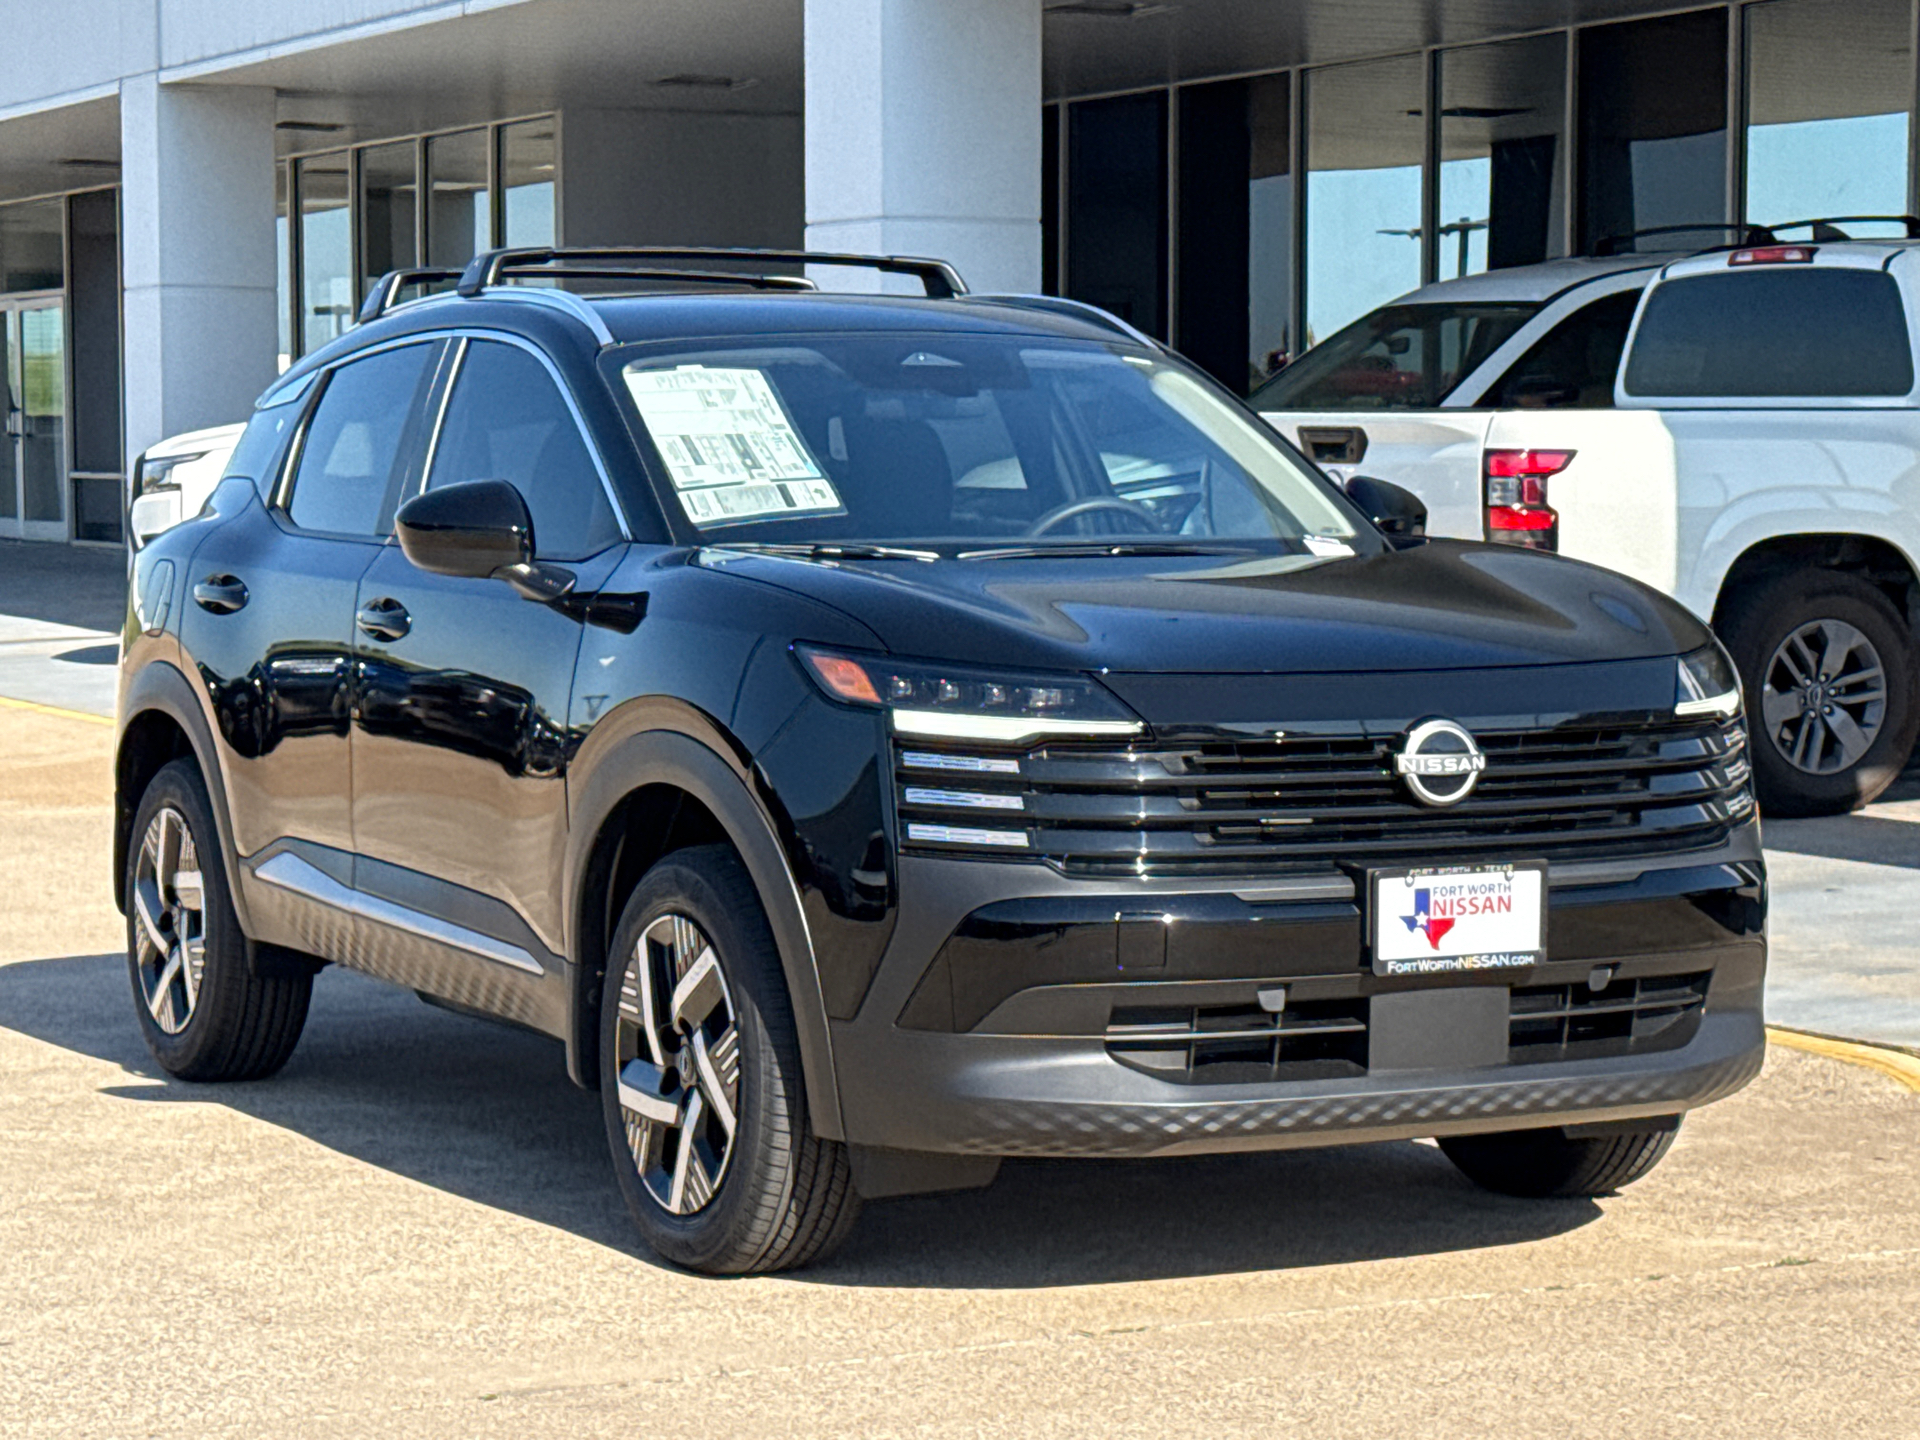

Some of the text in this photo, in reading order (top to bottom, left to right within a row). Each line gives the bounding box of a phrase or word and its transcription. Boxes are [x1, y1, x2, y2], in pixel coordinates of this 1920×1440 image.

[1398, 755, 1486, 772] NISSAN
[1409, 864, 1514, 877] FORT WORTH TEXAS
[1432, 883, 1512, 897] FORT WORTH
[1432, 895, 1512, 916] NISSAN
